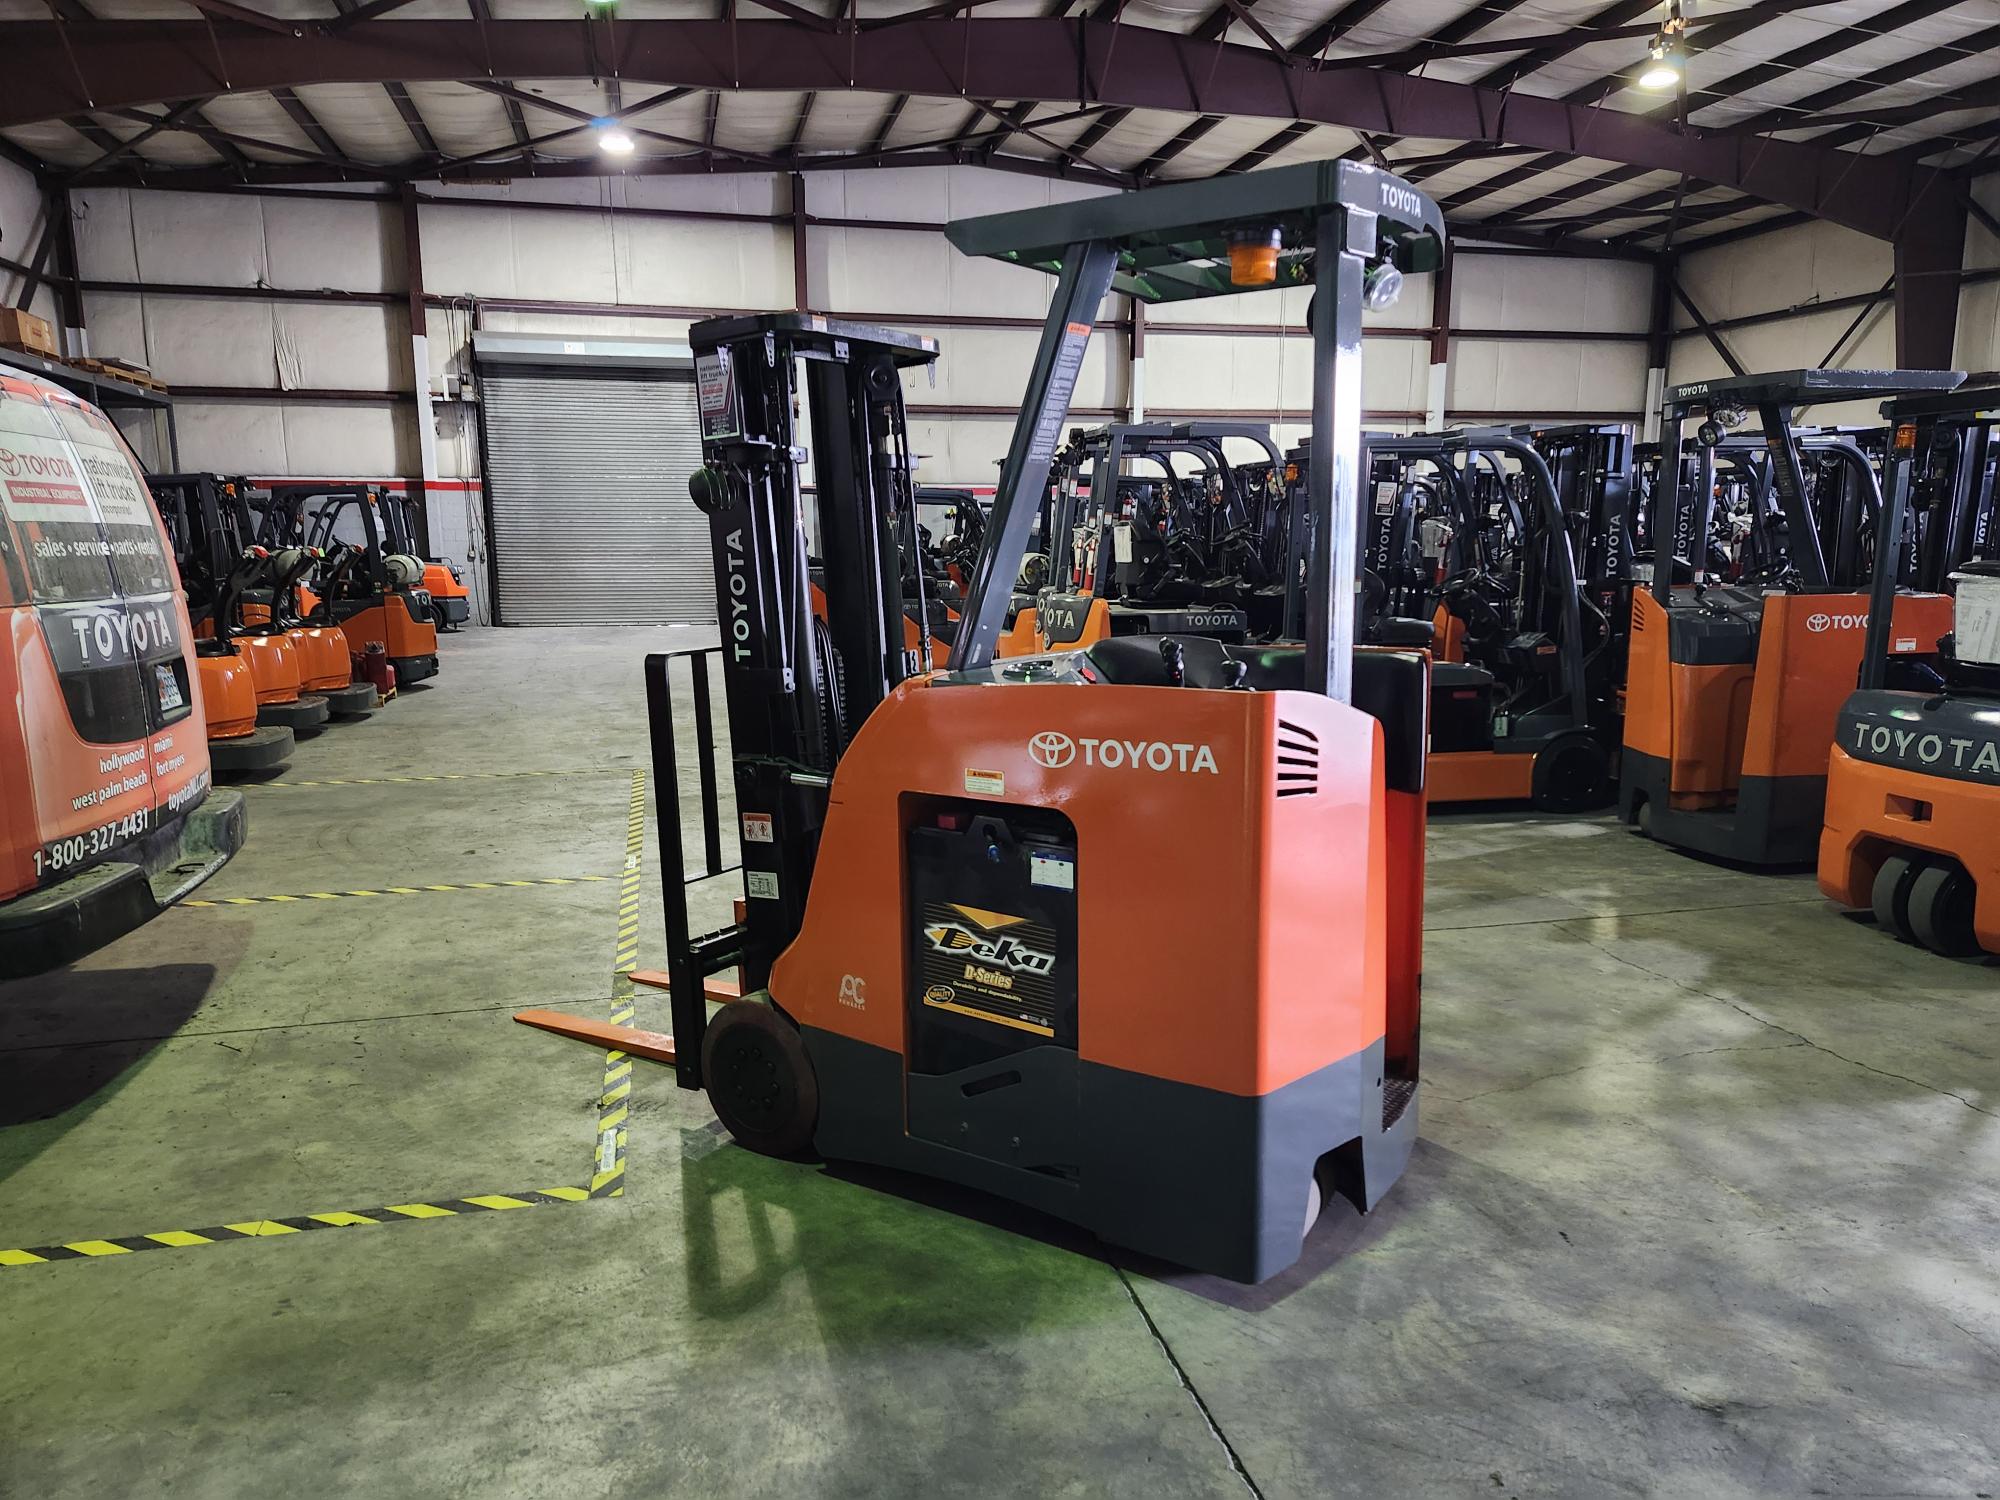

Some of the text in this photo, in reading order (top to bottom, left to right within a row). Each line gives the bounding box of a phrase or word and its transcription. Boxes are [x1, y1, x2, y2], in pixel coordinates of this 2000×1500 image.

[1380, 183, 1421, 218] TOYOTA
[1677, 384, 1708, 397] TOYOTA
[18, 454, 75, 478] TOYOTA
[81, 455, 133, 481] nationwide
[89, 476, 137, 502] lift trucks
[34, 536, 67, 558] sales
[73, 537, 111, 556] service
[114, 538, 136, 560] parts
[1377, 517, 1392, 572] TOYOTA
[1604, 514, 1621, 578] TOYOTA
[1676, 505, 1690, 560] TOYOTA
[725, 528, 752, 663] TOYOTA
[72, 609, 173, 660] TOYOTA
[1186, 614, 1238, 626] TOYOTA
[99, 744, 146, 774] hollywood
[153, 733, 174, 754] miami
[1079, 738, 1219, 775] TOYOTA
[1853, 721, 2000, 778] TOYOTA
[155, 753, 186, 777] fort myers
[72, 769, 148, 811] west palm beach
[32, 806, 149, 877] 1-800-327-4431
[924, 922, 1057, 977] Deka
[963, 962, 1014, 990] D-Series
